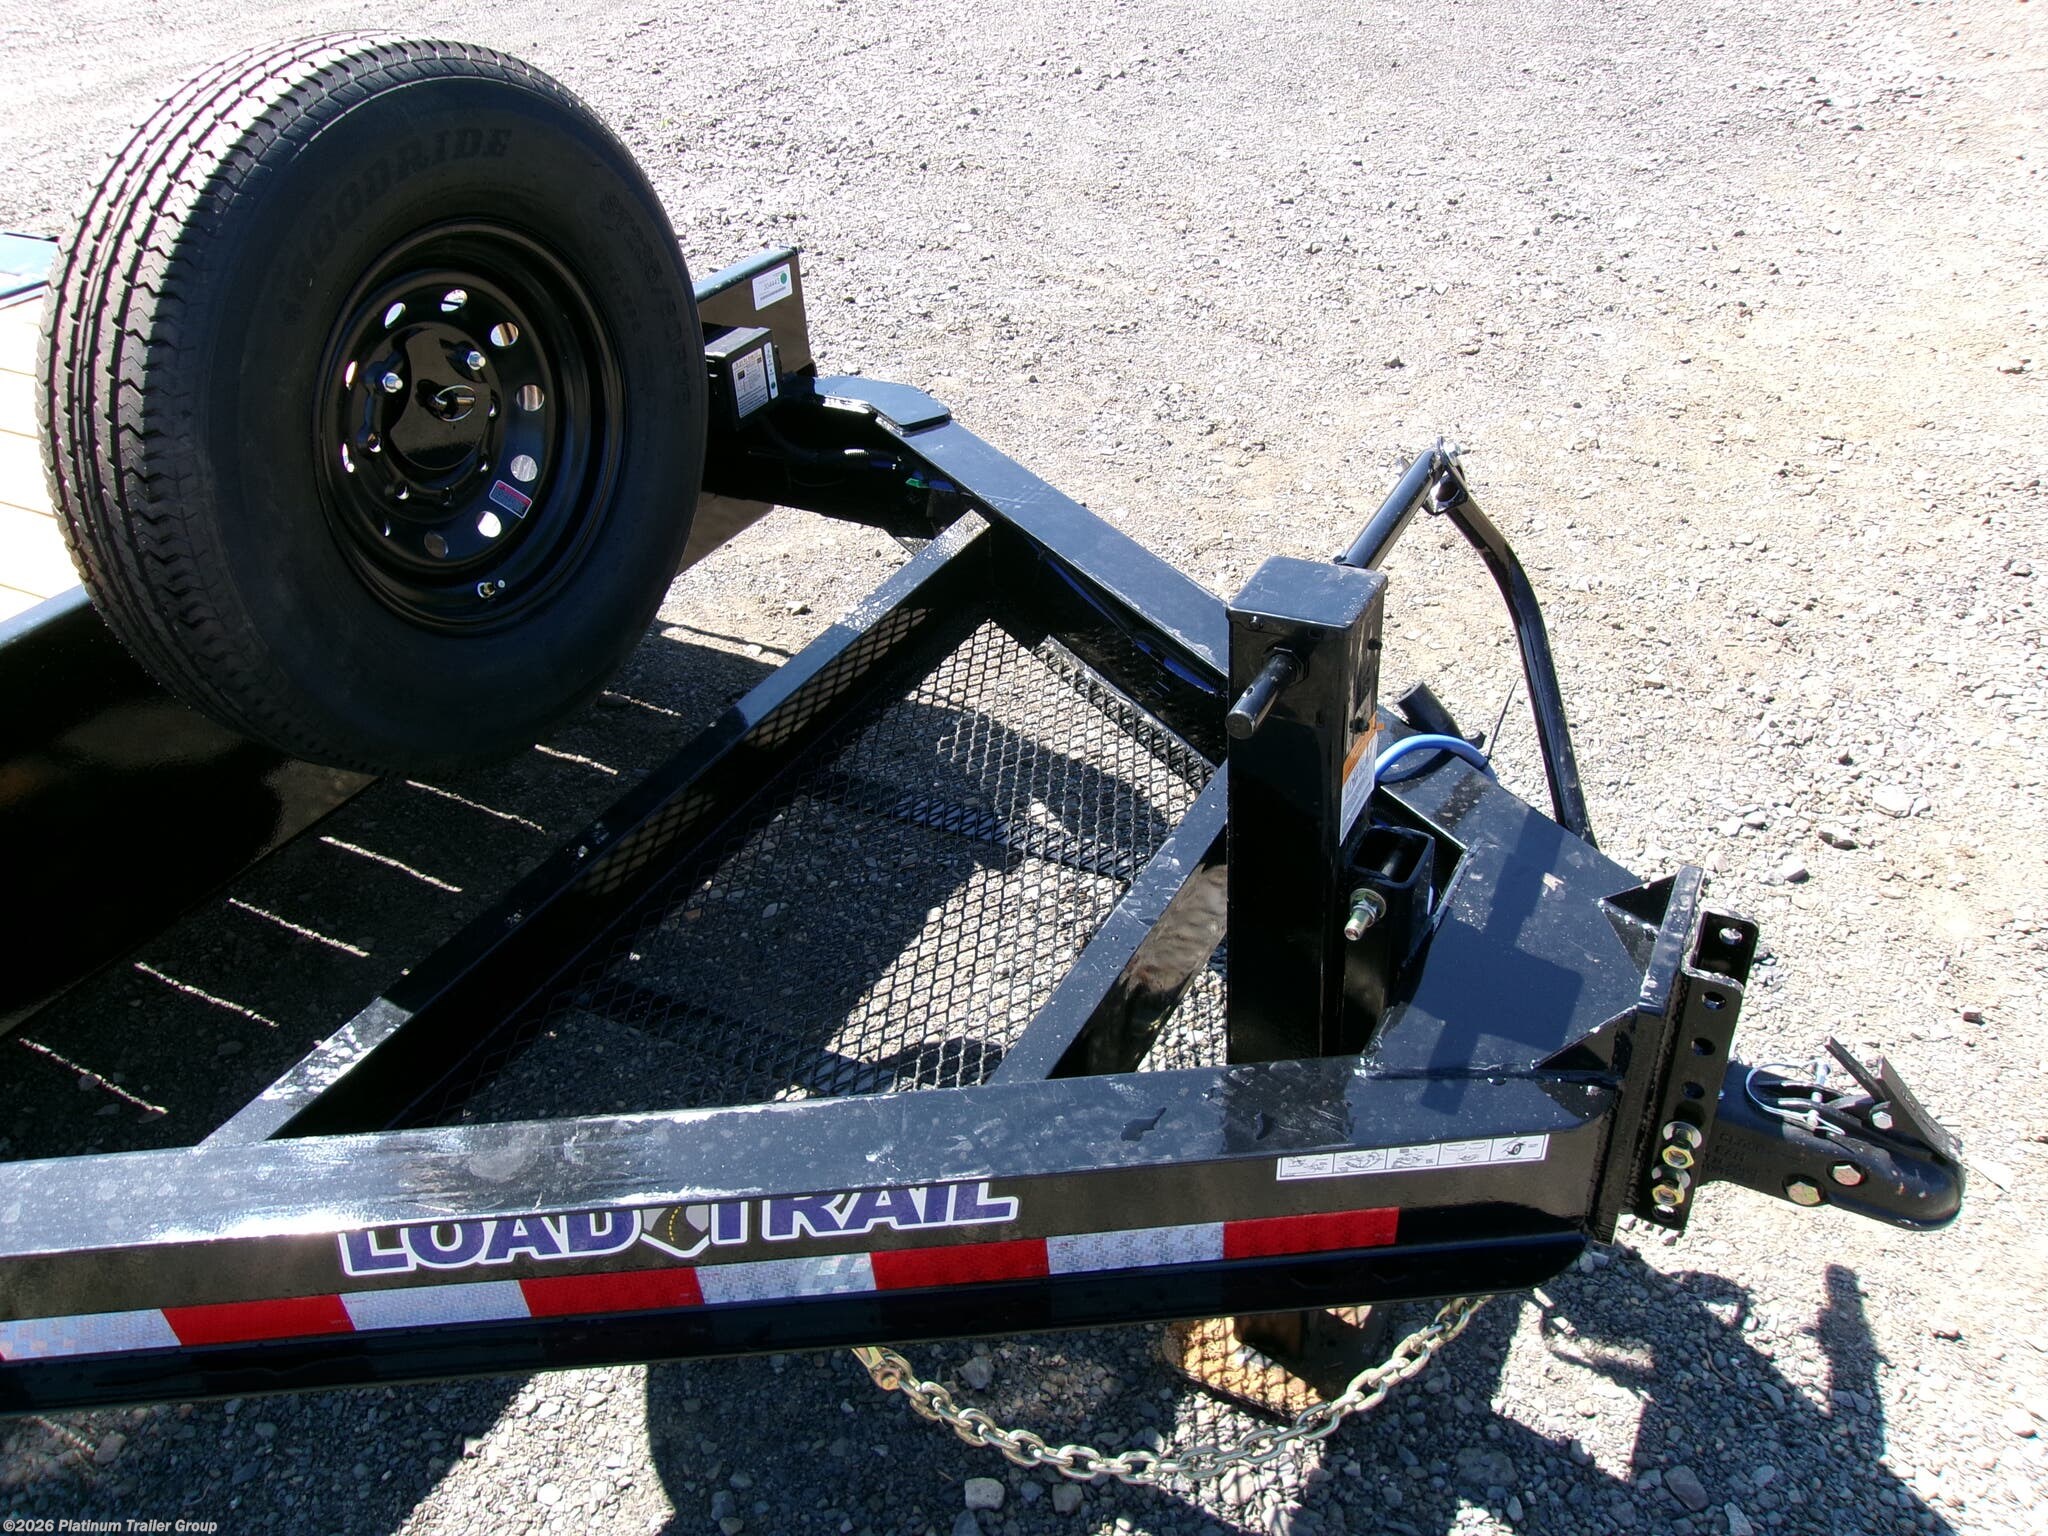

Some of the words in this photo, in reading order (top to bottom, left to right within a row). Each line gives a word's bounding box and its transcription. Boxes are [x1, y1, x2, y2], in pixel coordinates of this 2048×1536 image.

[282, 124, 513, 298] GOODRIDE
[338, 1210, 642, 1276] LOAD
[710, 1183, 1019, 1245] TRAIL
